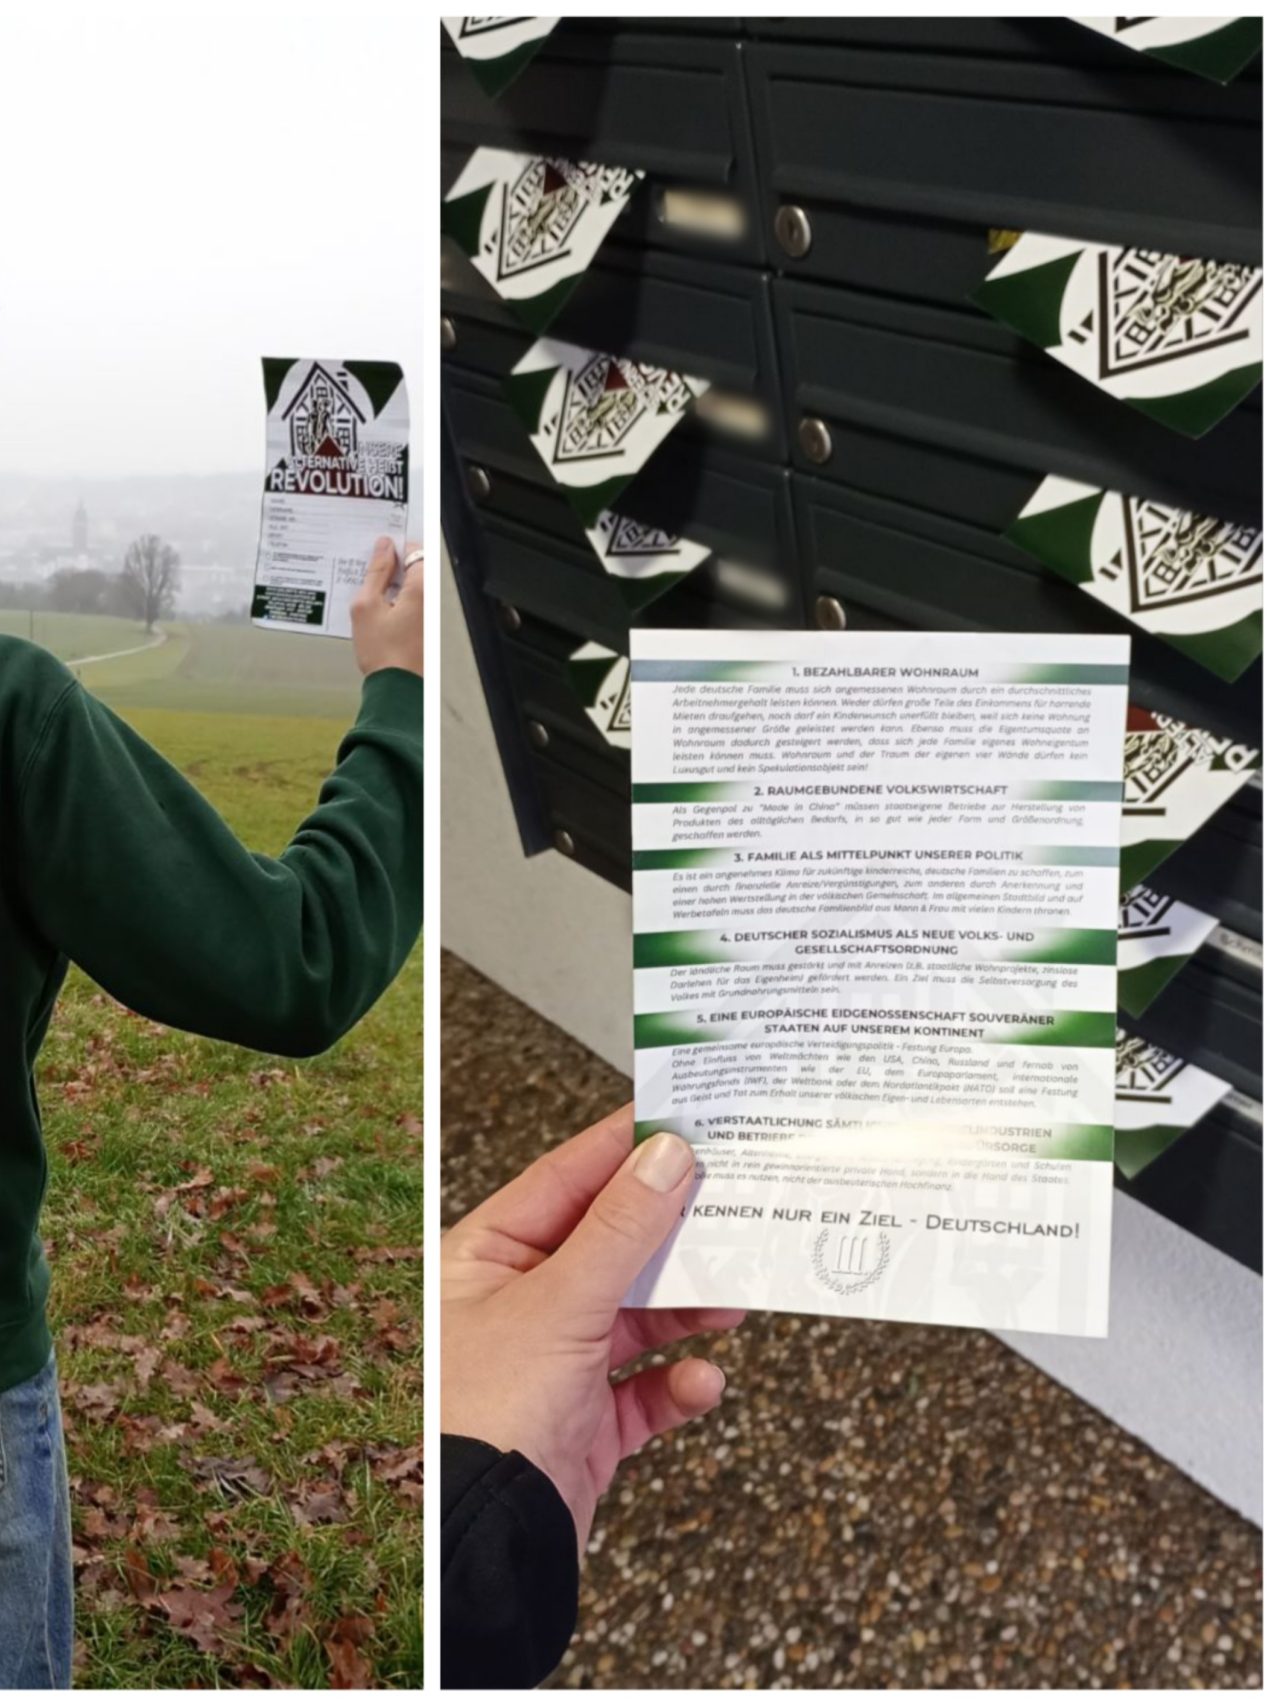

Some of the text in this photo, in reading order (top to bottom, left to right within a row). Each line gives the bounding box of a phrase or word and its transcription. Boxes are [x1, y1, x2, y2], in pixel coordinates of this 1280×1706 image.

[270, 467, 404, 500] REVOLUTION!
[792, 667, 978, 677] 1. BEZAHLBARER WOHNRAUM
[754, 785, 1006, 796] 2. RAUMGEBUNDENE VOLKSWIRTSCHAFT
[734, 850, 1022, 862] 3. FAMILIE ALS MITTELPUNKT UNSERER POLITIK
[720, 930, 1034, 943] 4. DEUTSCHER SOZIALISMUS ALS NEUE VOLKS- UND
[795, 945, 957, 955] GESELLSCHAFTSORDNUNG
[697, 1007, 1053, 1025] 5. EINE EUROPÄISCHE EIDGENOSSENSCHAFT SOUVERÄNER
[764, 1024, 983, 1037] STAATEN AUF UNSEREM KONTINENT
[694, 1118, 703, 1127] 6.
[708, 1116, 822, 1127] VERSTAATLICHUNG
[708, 1131, 734, 1141] UND
[693, 1204, 764, 1219] KENNEN
[772, 1209, 812, 1222] NUR
[821, 1211, 851, 1225] EIN
